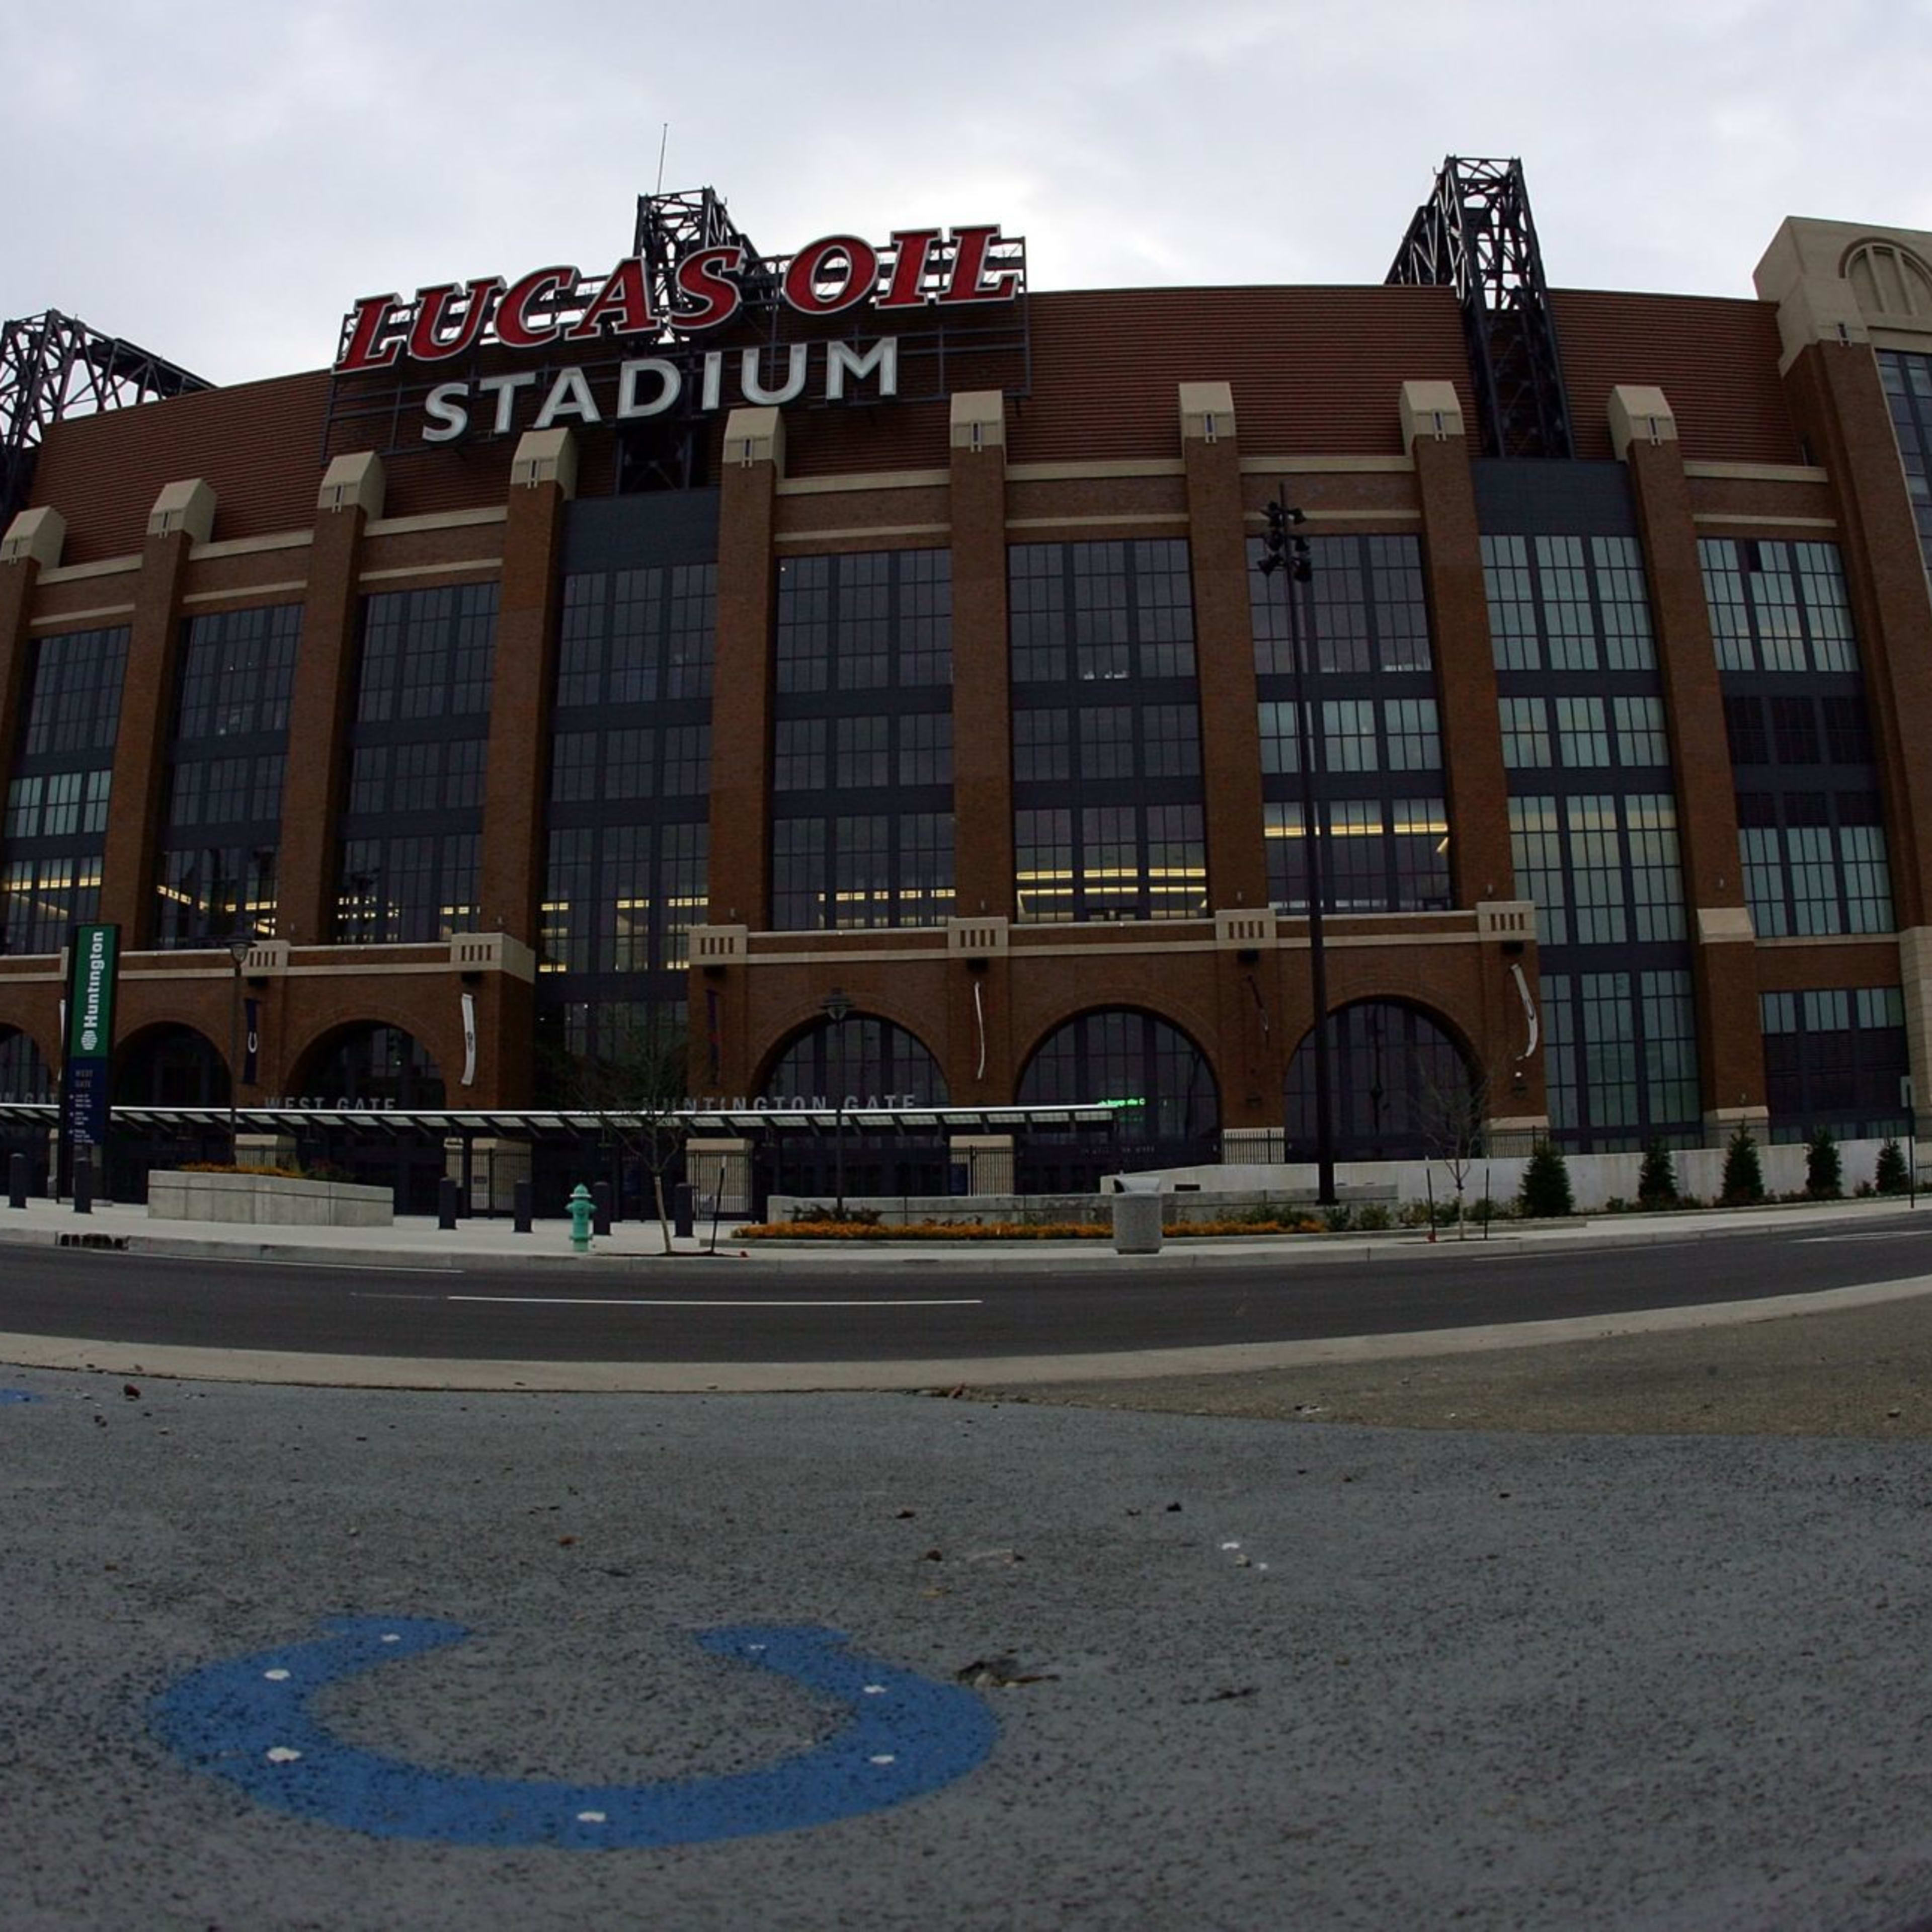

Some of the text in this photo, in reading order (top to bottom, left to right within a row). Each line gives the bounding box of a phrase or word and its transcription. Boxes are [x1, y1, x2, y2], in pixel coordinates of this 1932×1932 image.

[332, 224, 1021, 374] LUCAS OIL
[422, 336, 898, 441] STADIUM
[83, 931, 106, 1028] Huntington
[23, 1092, 57, 1104] GAT
[264, 1096, 396, 1110] WEST GATE
[843, 1094, 916, 1109] GATE
